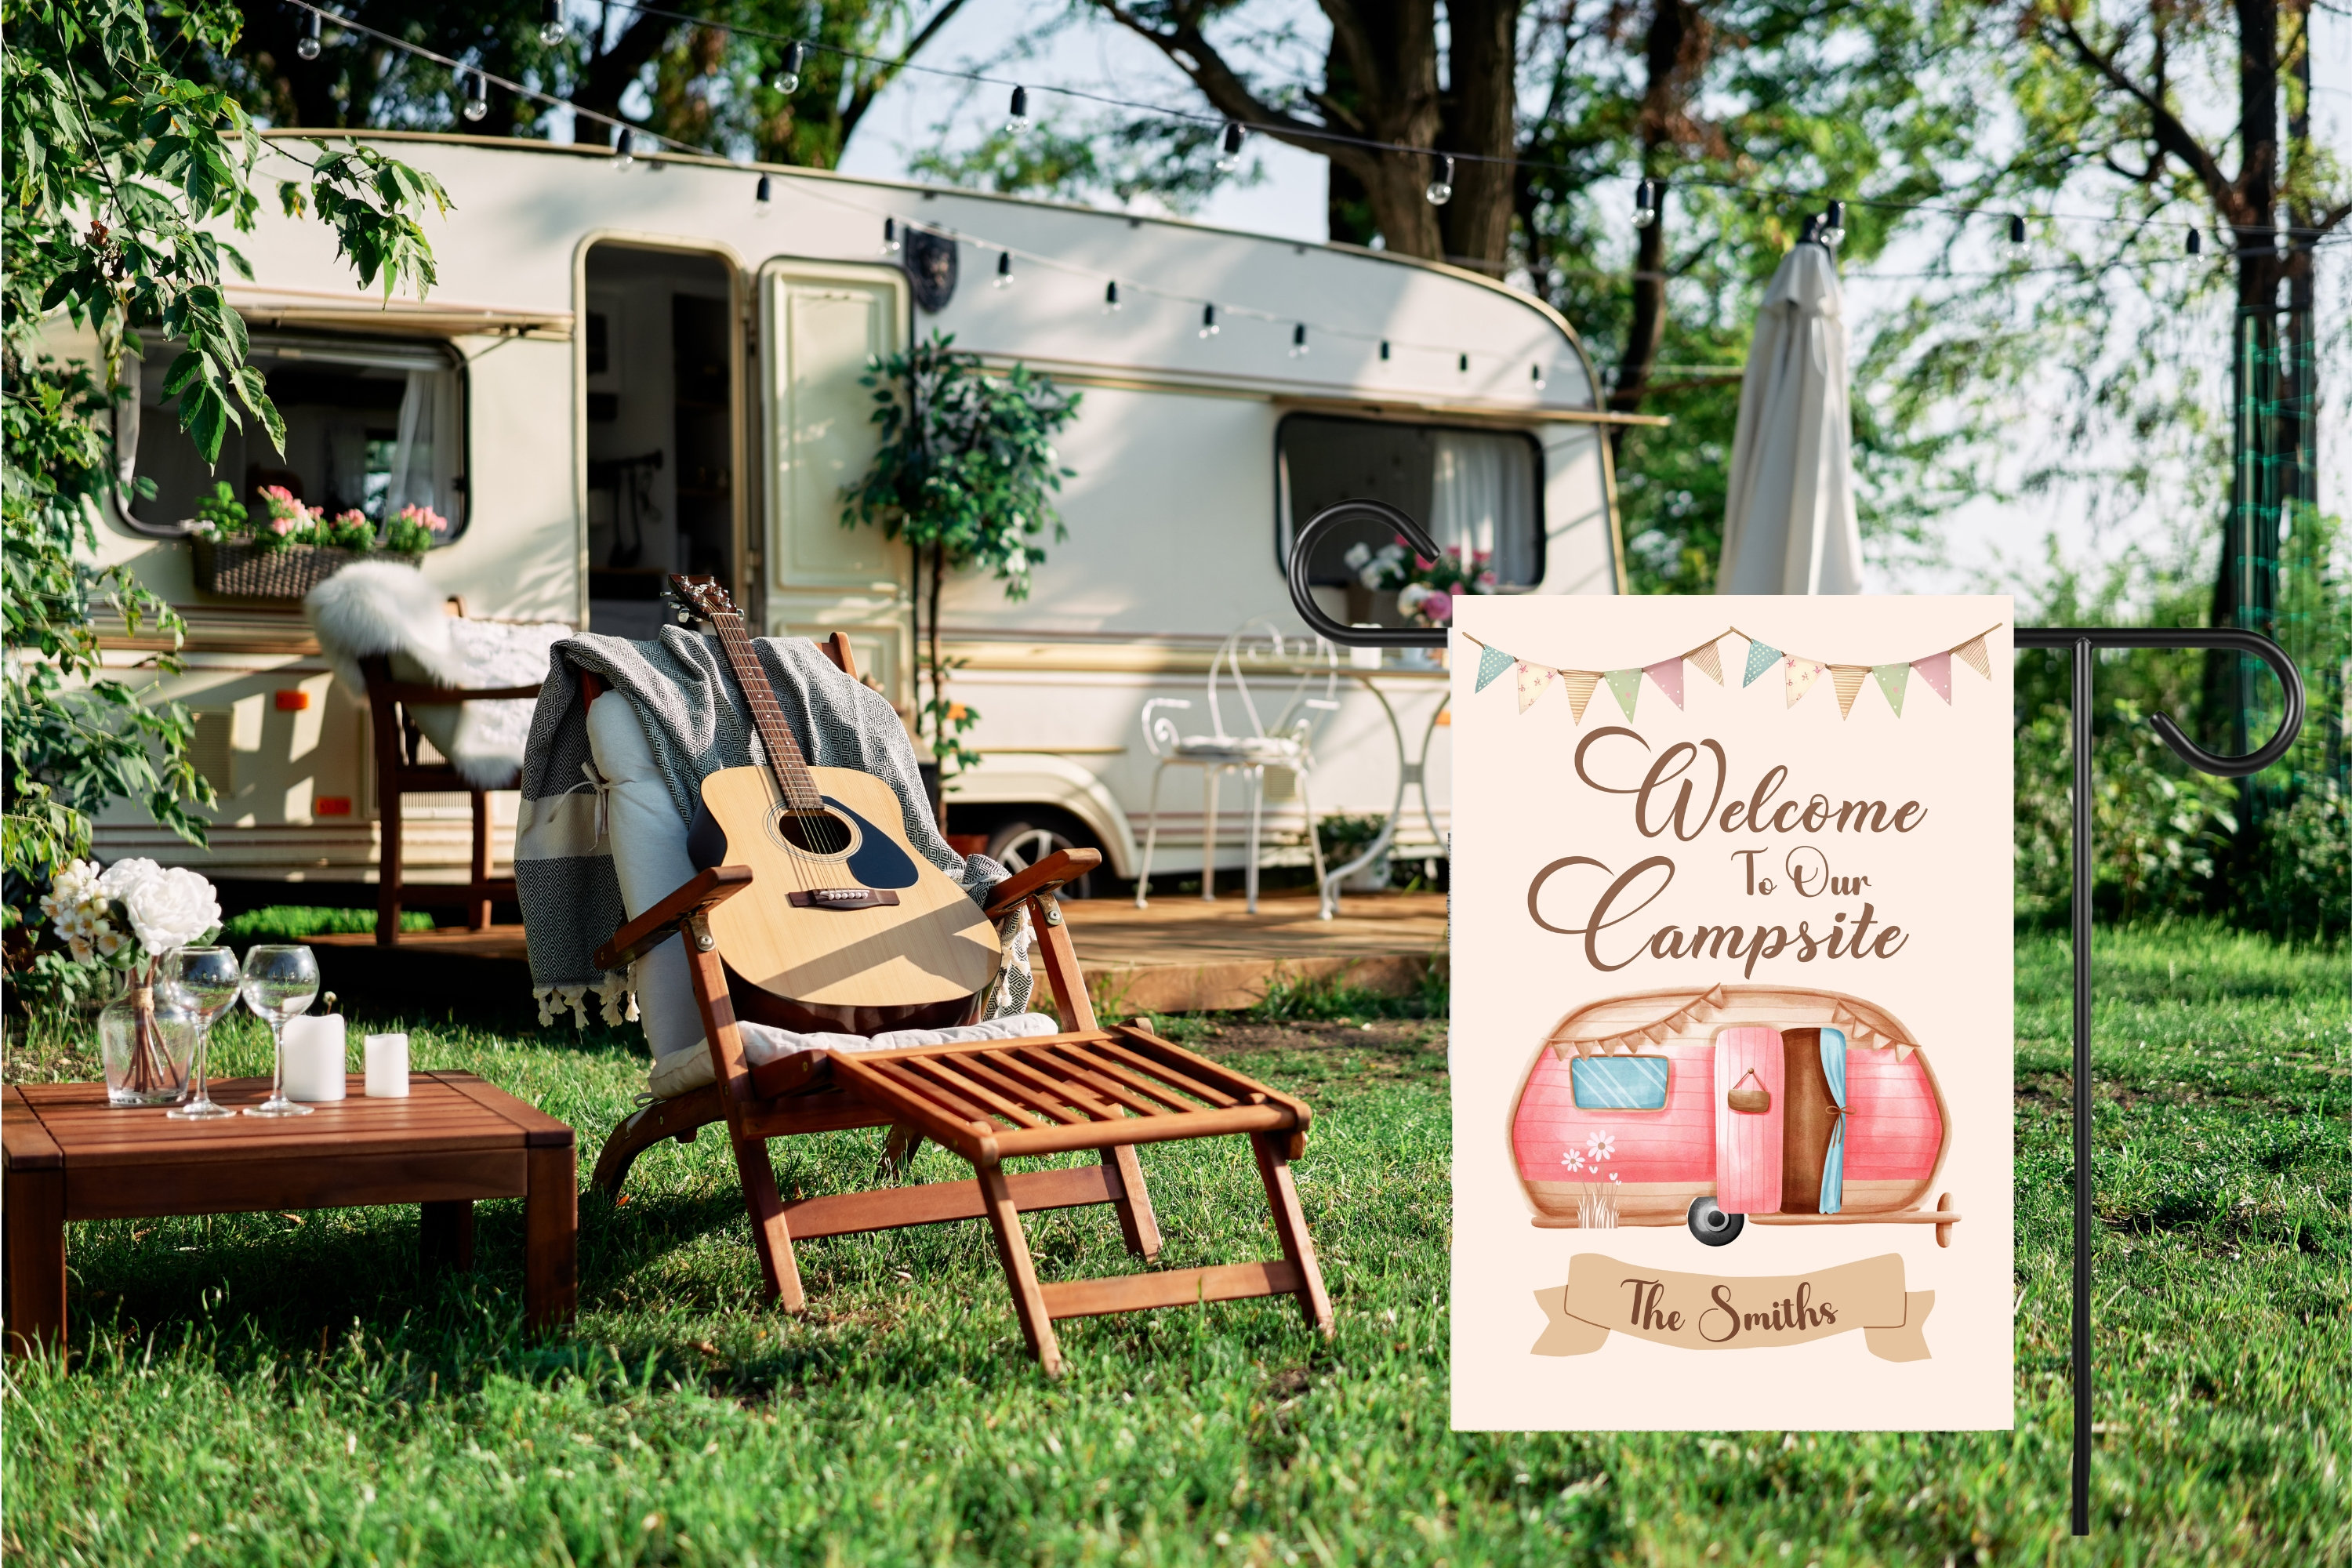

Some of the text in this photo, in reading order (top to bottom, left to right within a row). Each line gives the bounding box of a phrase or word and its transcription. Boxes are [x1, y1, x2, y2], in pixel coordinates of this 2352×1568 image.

[1574, 726, 1928, 842] Welcome
[1731, 845, 1871, 898] To Our
[1527, 855, 1909, 980] Campsite
[1620, 1278, 1838, 1343] The Smiths
